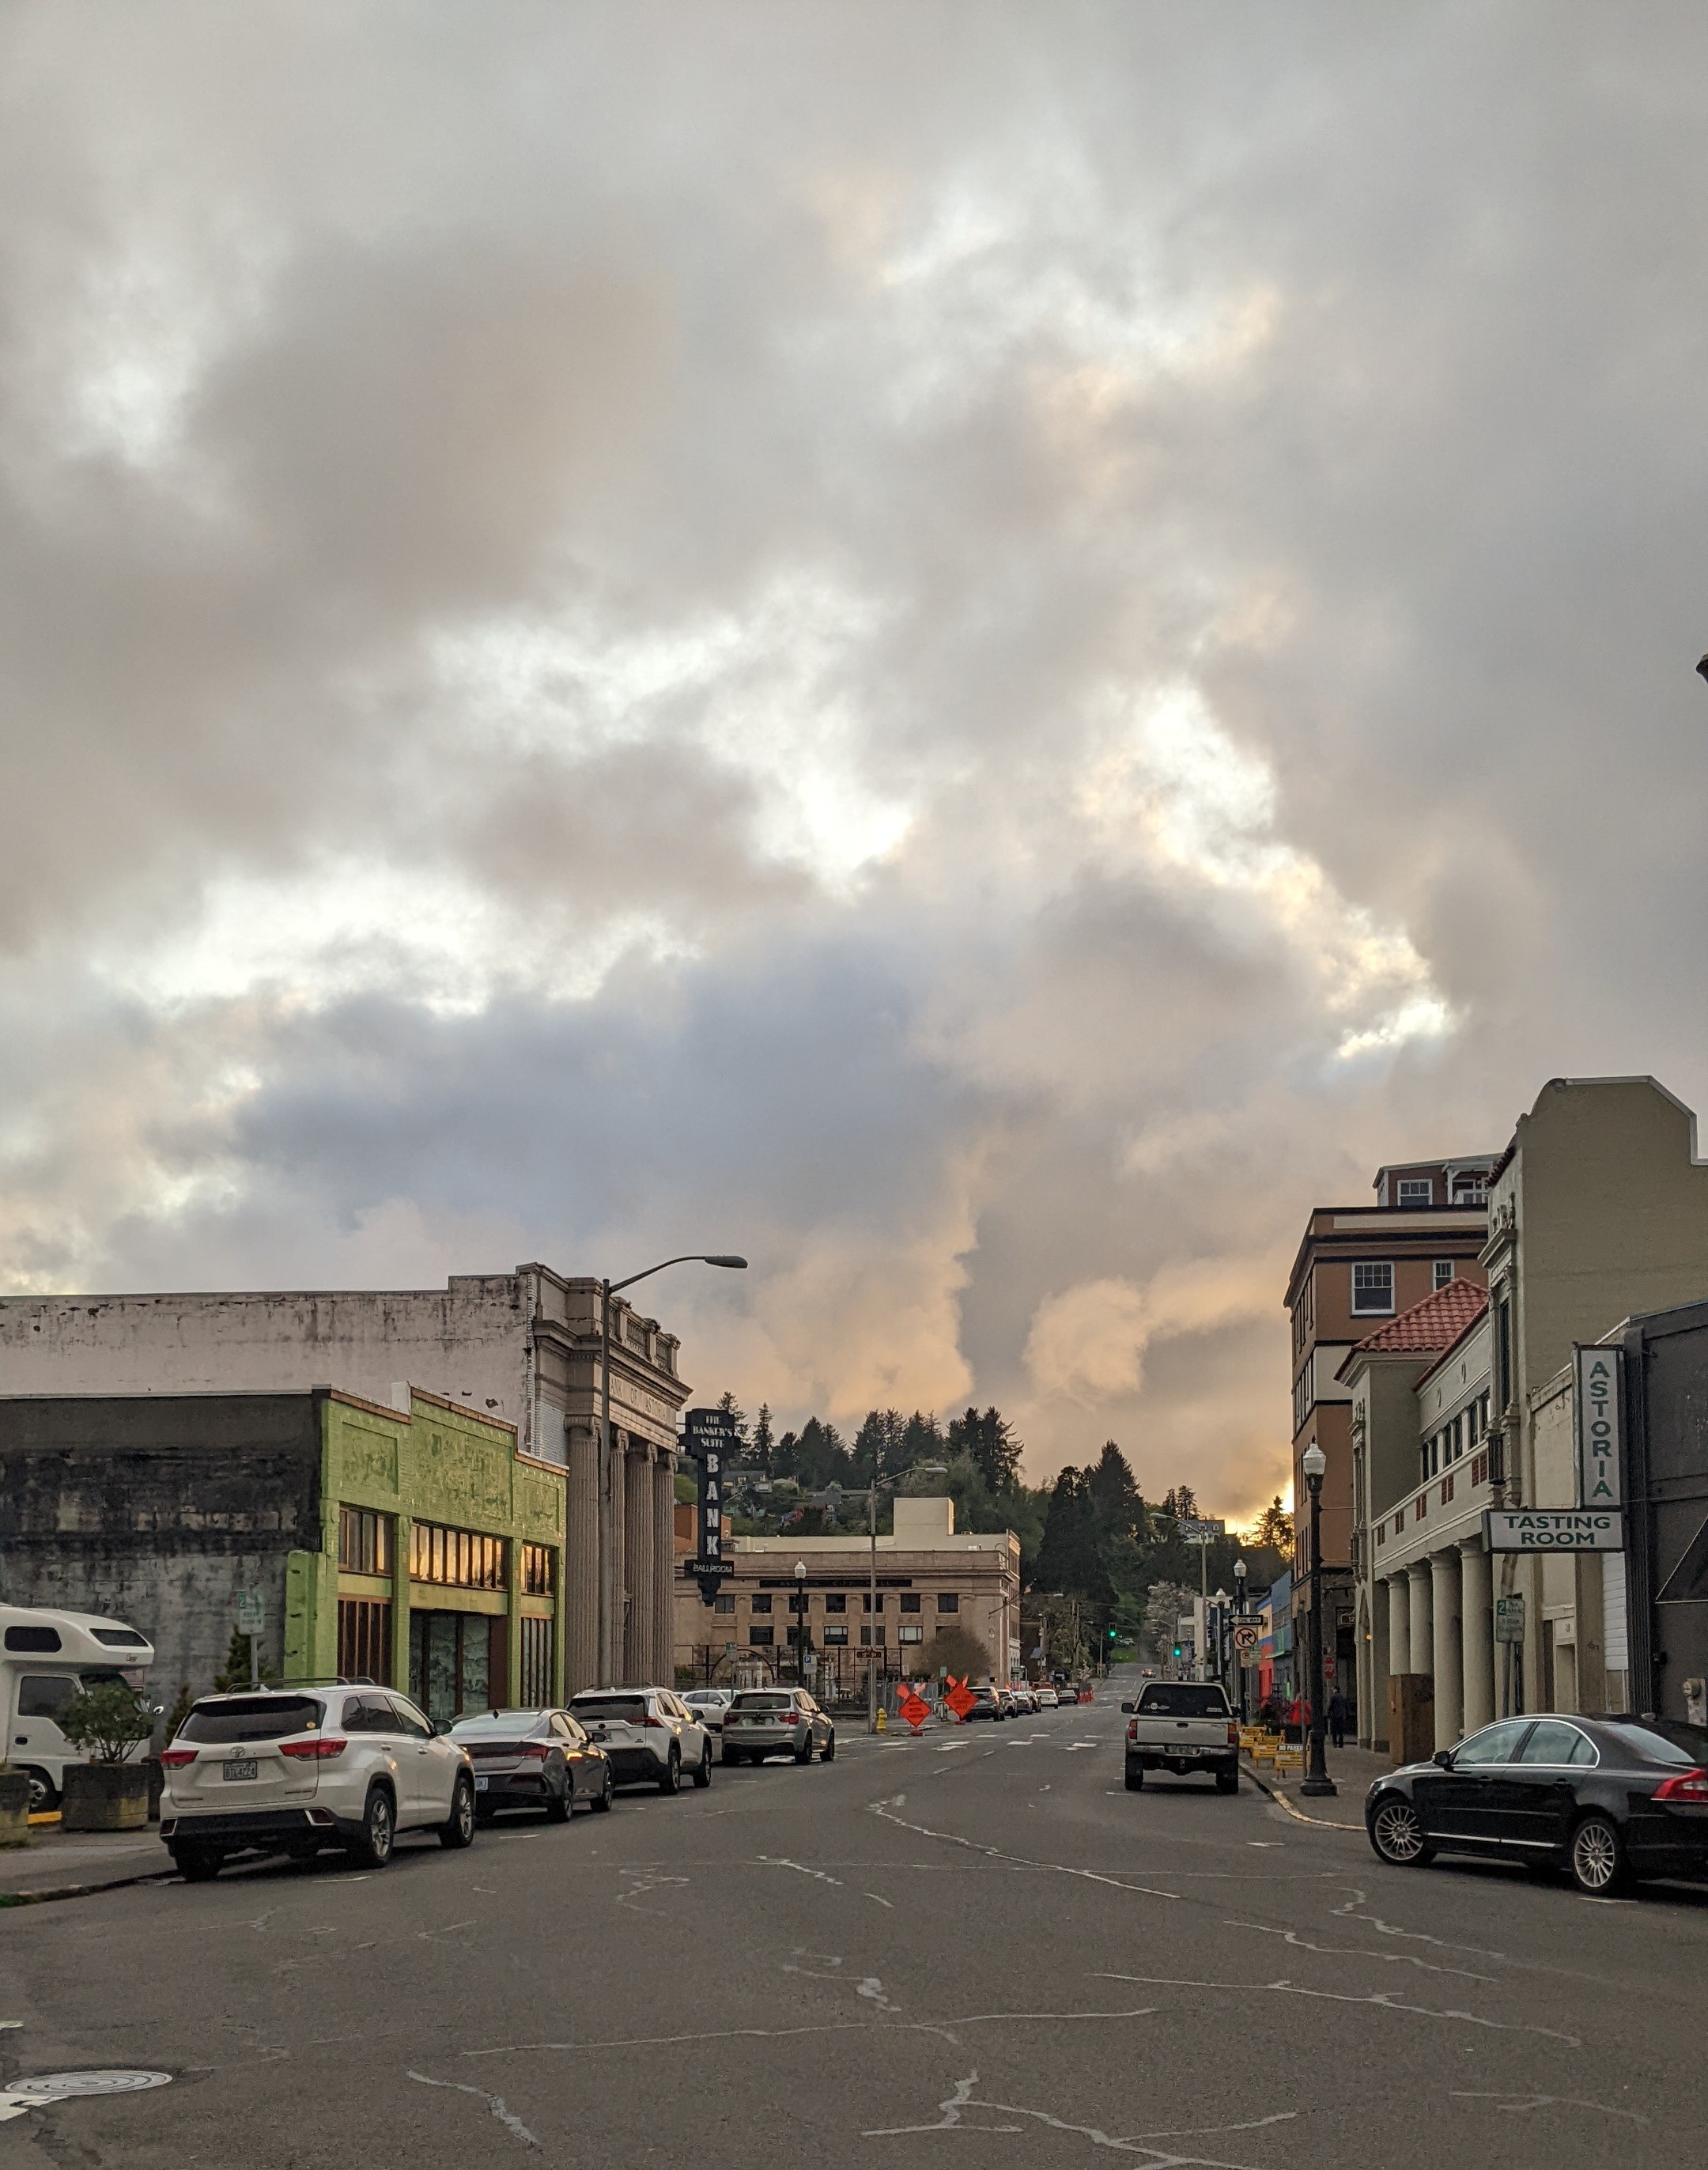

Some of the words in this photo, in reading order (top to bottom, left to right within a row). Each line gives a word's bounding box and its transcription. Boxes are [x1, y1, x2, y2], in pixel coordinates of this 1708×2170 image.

[610, 1377, 622, 1398] ANK
[630, 1387, 638, 1405] OF
[644, 1397, 666, 1421] ASTORIA
[705, 1415, 722, 1424] THE
[693, 1425, 733, 1438] BANKER'S
[1589, 1360, 1613, 1498] ASTORIA
[701, 1438, 724, 1448] SUITE
[705, 1454, 720, 1556] BANK
[1503, 1516, 1611, 1529] TASTING
[1521, 1532, 1595, 1545] ROOM
[693, 1563, 732, 1573] BALLROOM
[1498, 1602, 1506, 1614] 2
